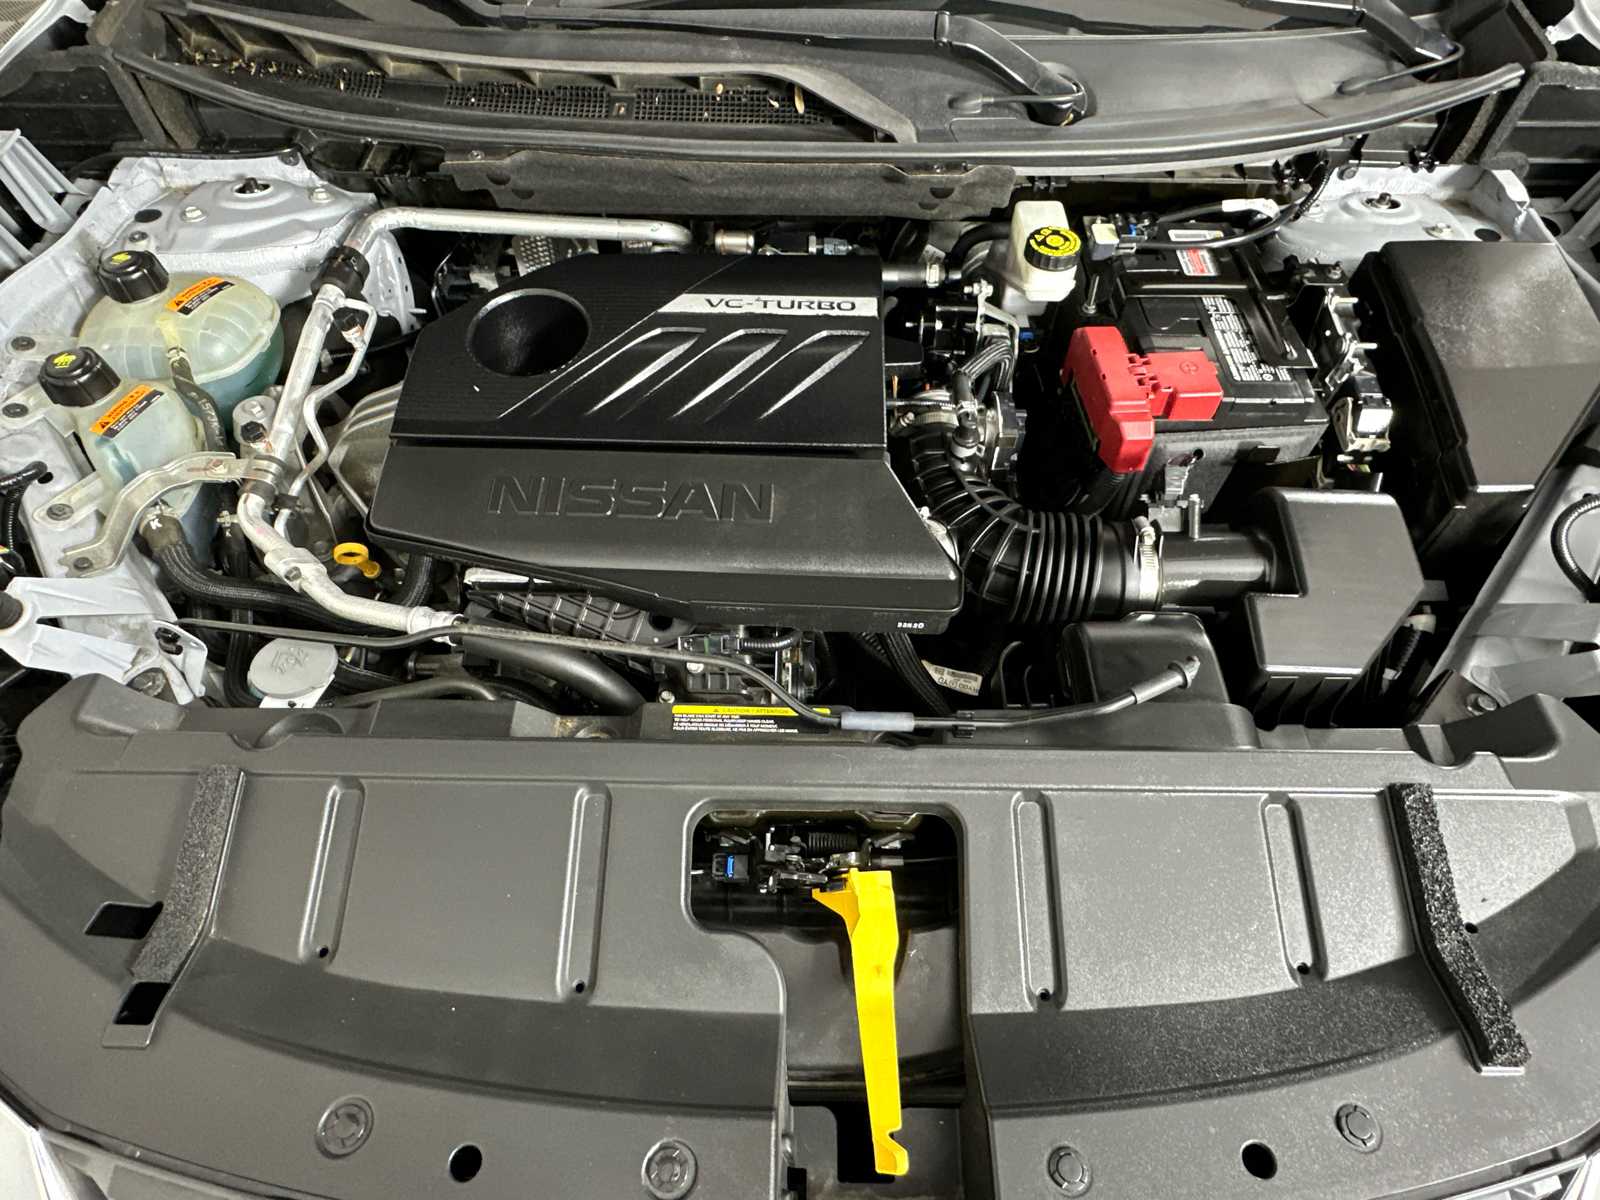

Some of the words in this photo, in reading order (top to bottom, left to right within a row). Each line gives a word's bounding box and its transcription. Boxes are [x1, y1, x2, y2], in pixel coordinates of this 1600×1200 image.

[705, 298, 856, 311] VC-TURBO
[487, 476, 776, 523] NISSAN
[150, 518, 163, 530] K
